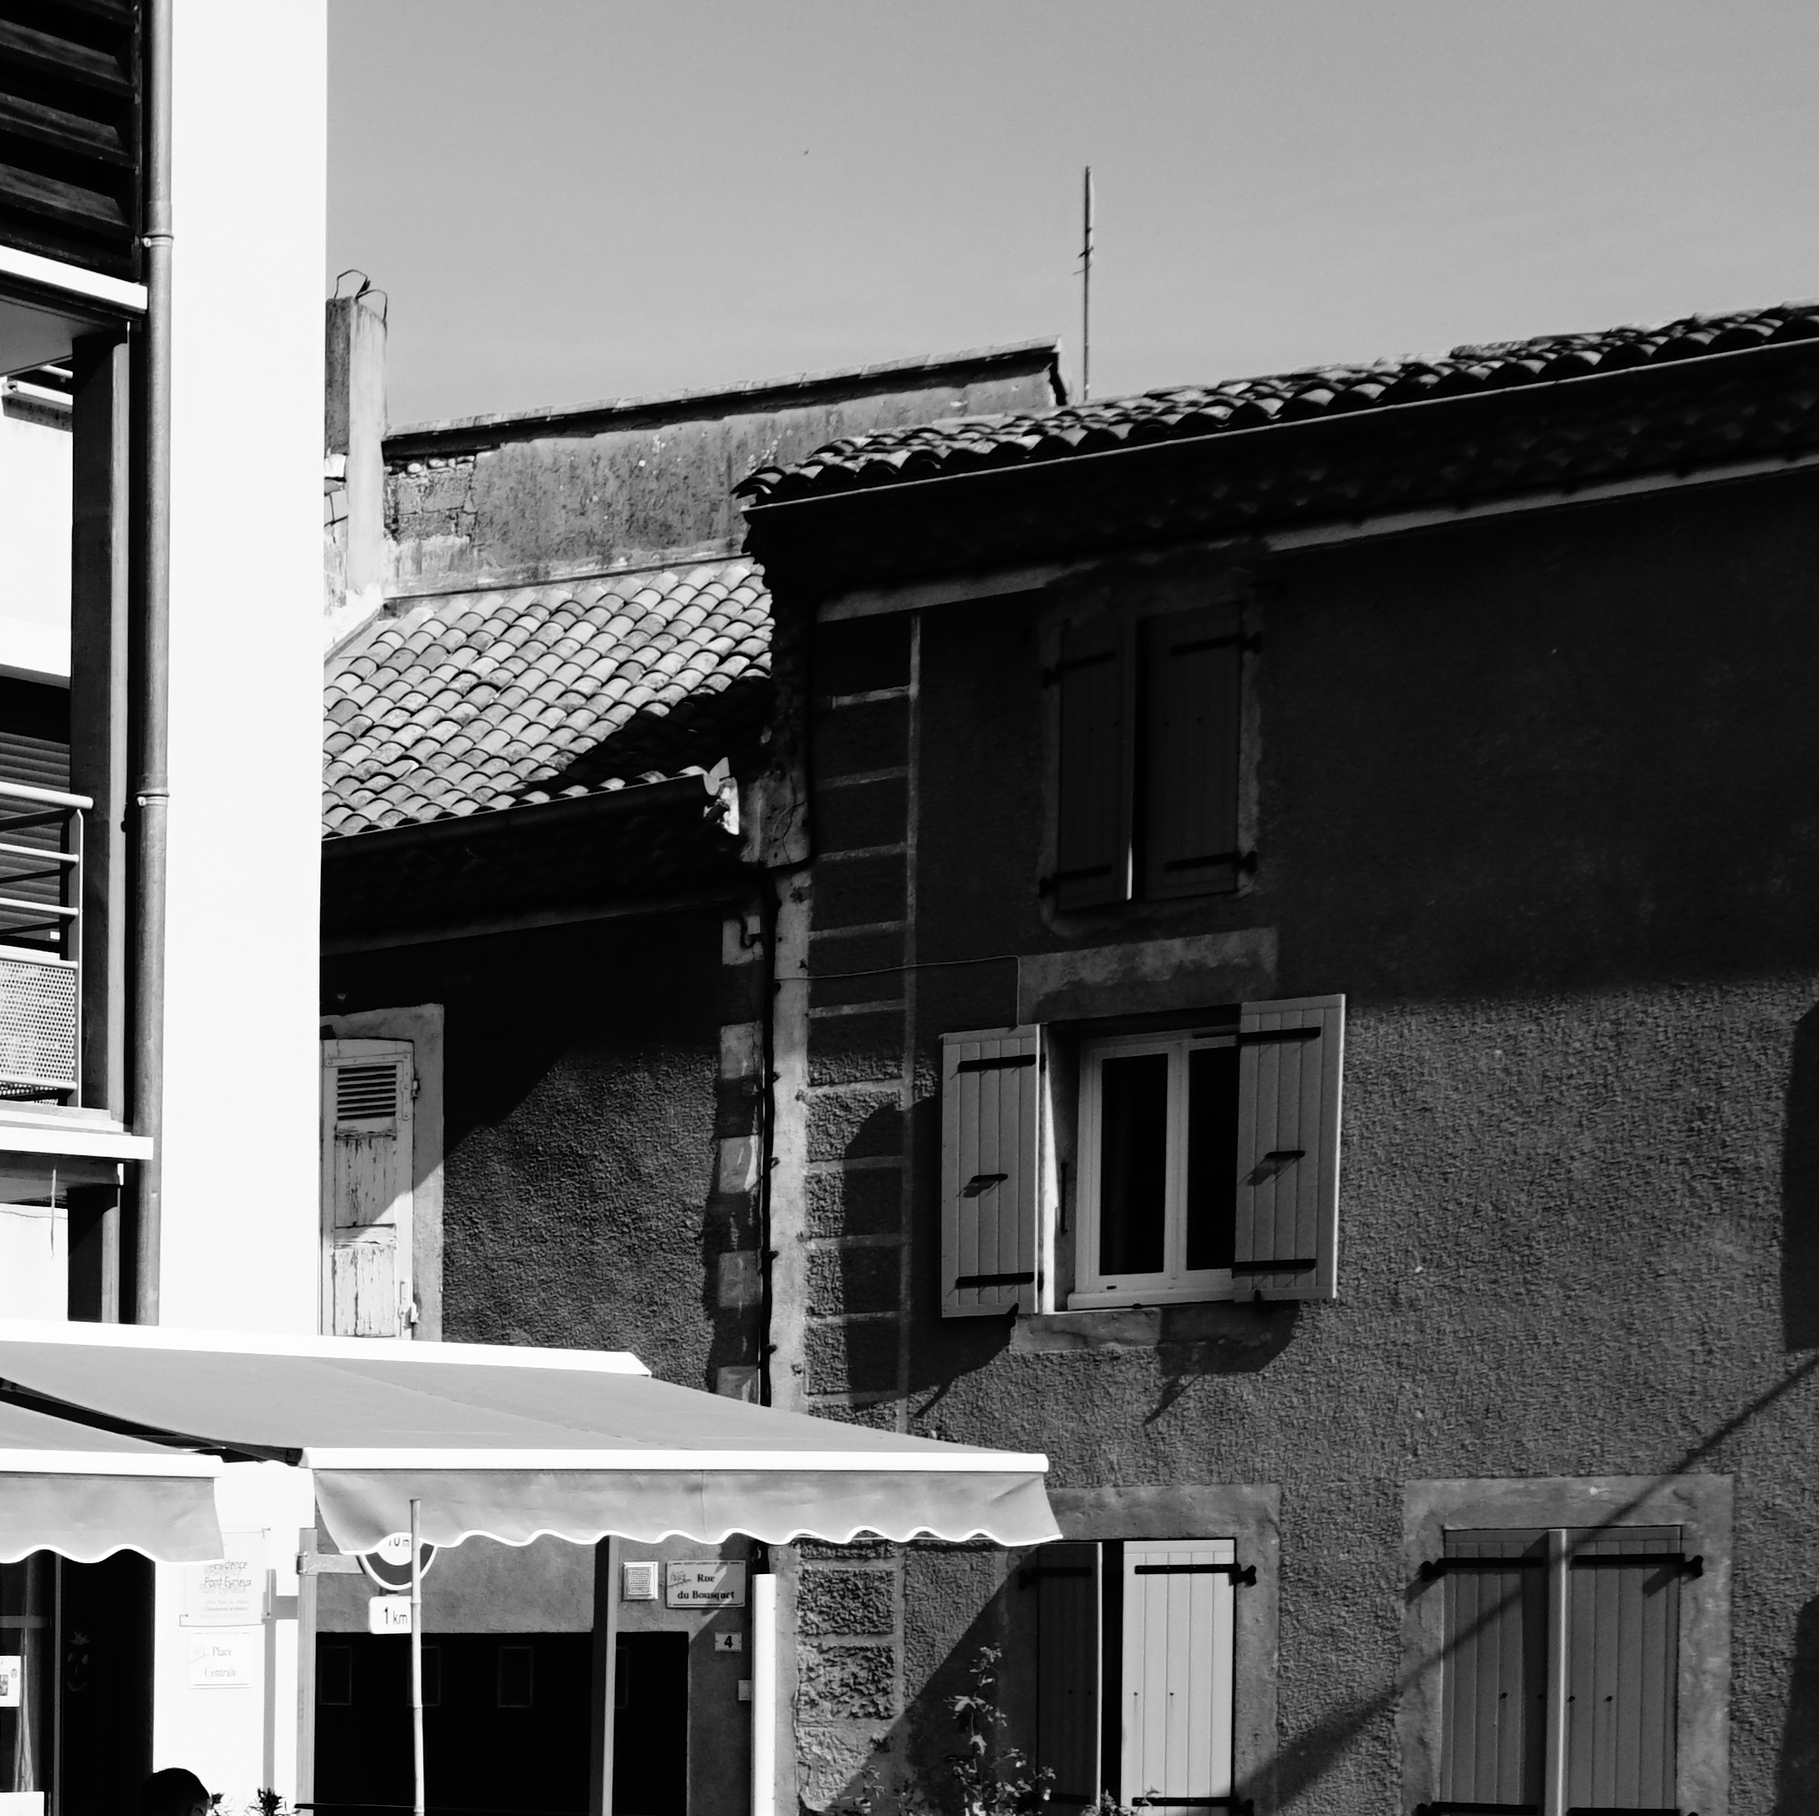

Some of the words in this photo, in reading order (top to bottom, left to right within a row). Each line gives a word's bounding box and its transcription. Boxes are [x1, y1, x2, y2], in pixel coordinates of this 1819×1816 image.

[697, 1573, 715, 1583] Rue
[677, 1590, 689, 1600] du
[393, 1610, 408, 1625] km
[723, 1635, 734, 1649] 4
